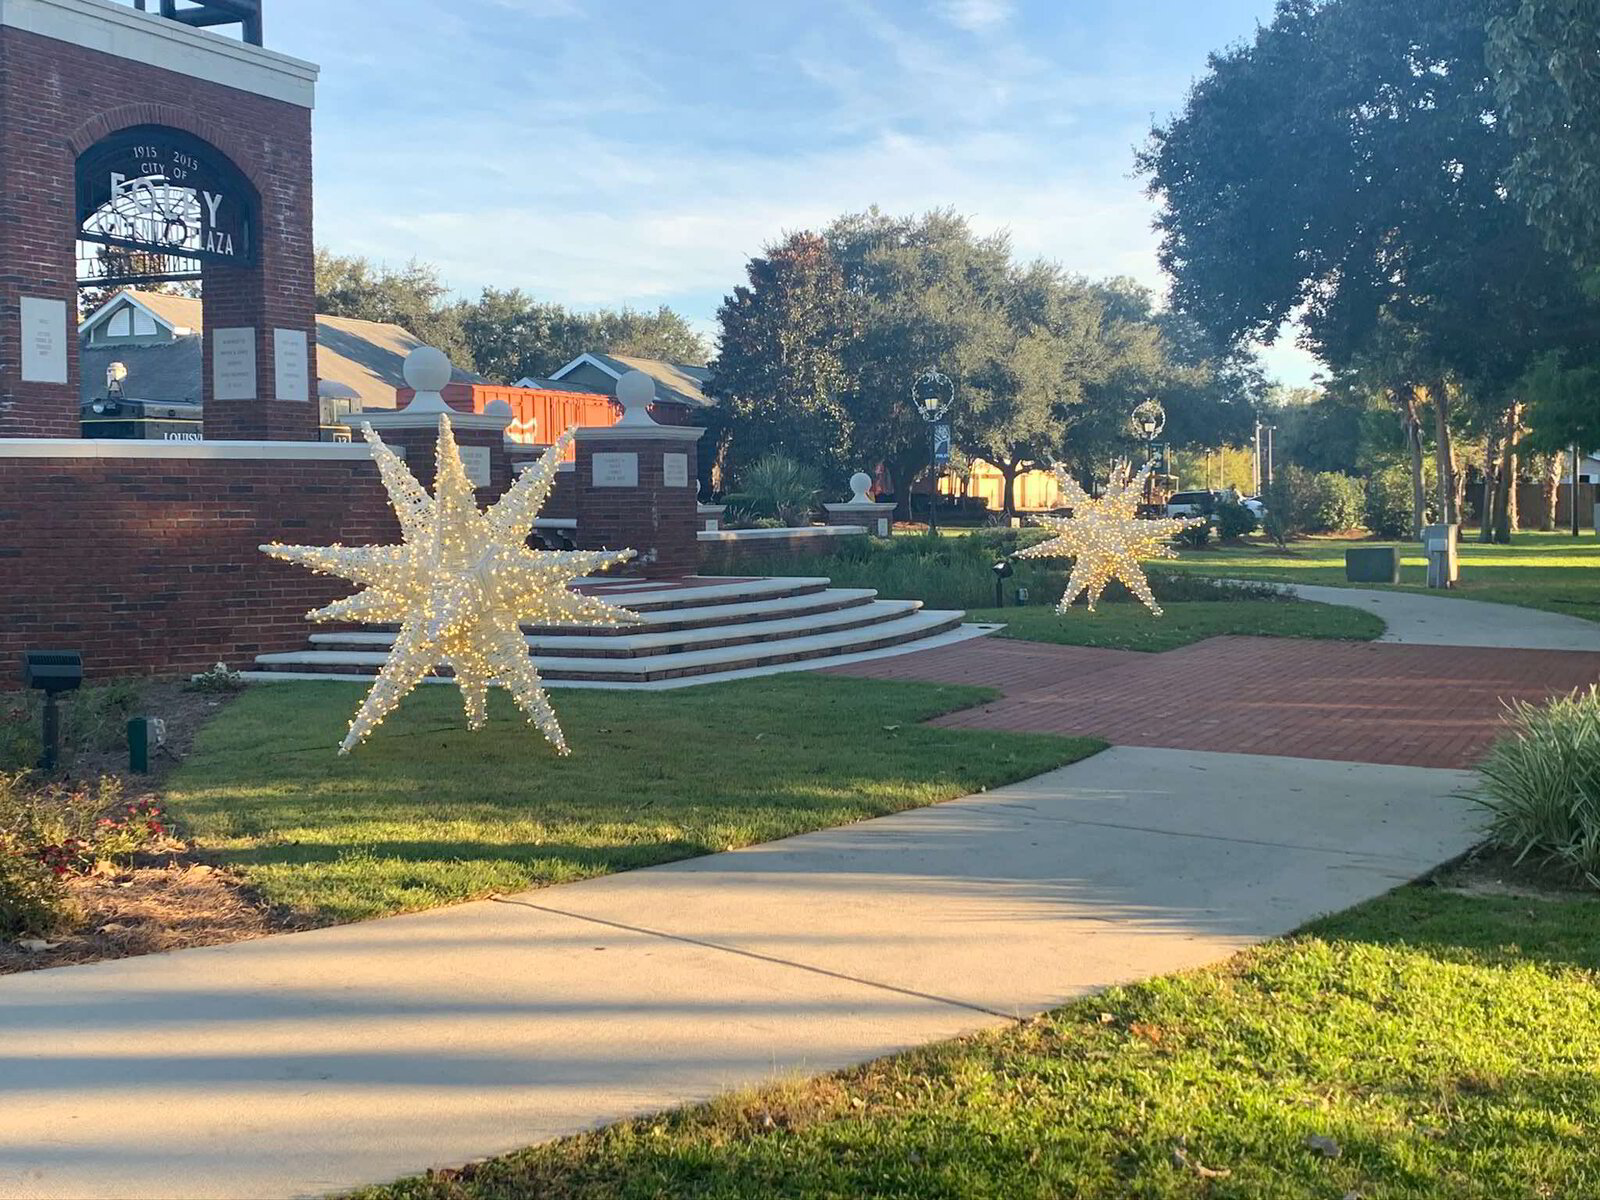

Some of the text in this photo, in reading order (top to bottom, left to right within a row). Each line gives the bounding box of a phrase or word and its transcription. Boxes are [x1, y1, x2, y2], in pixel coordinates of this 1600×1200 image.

[133, 145, 198, 171] 1915 2015
[141, 162, 187, 180] CITY OF
[111, 171, 223, 228] FOLEY
